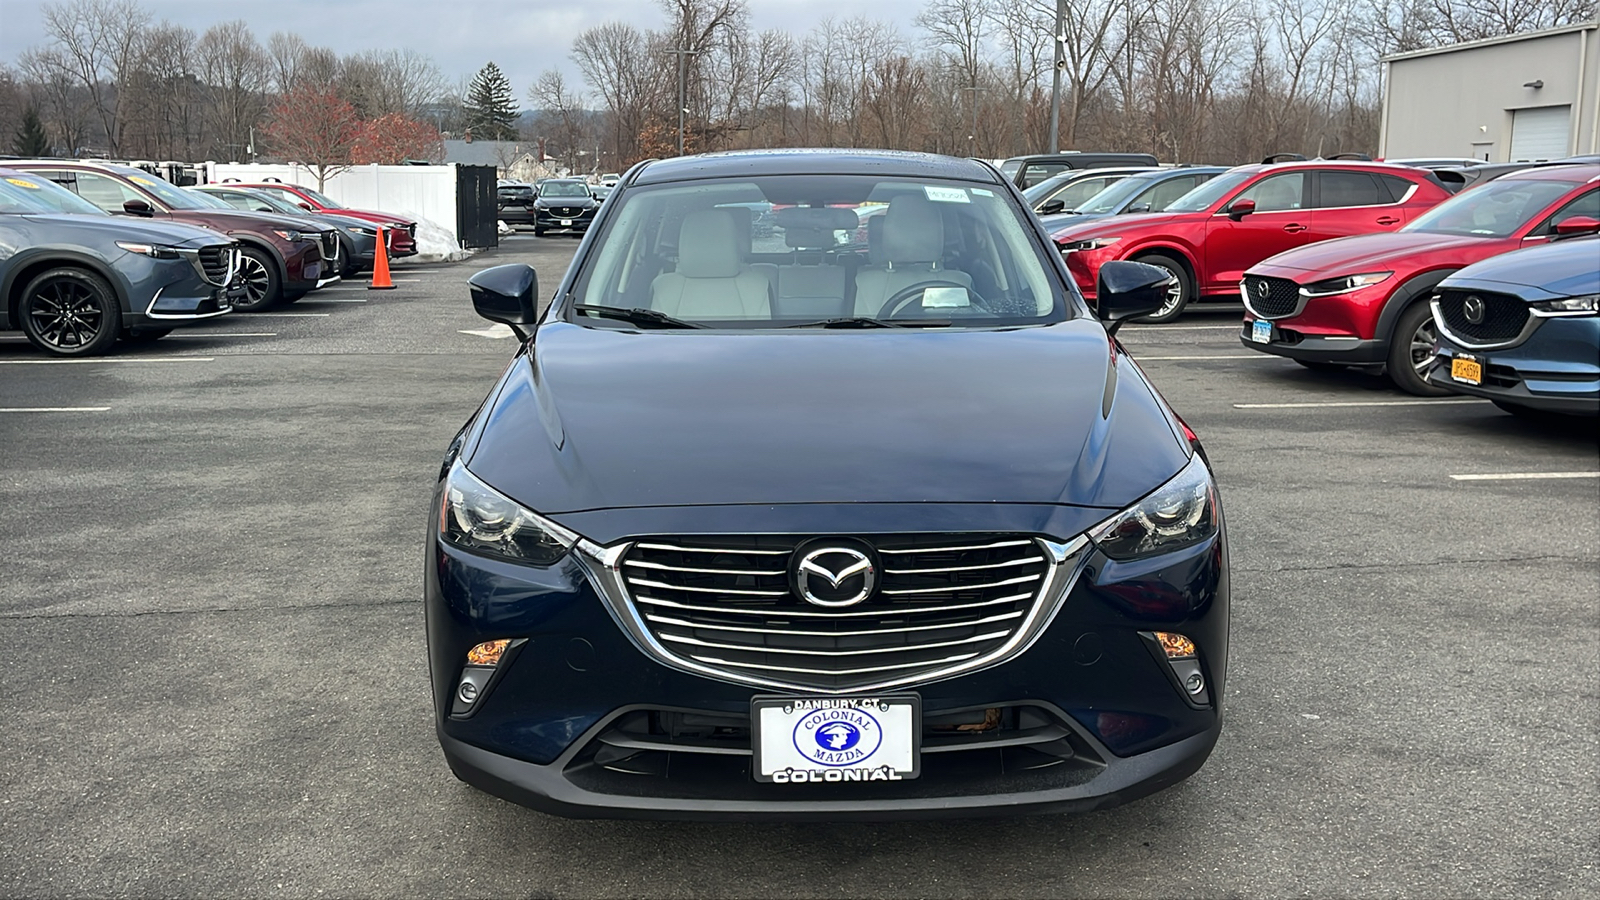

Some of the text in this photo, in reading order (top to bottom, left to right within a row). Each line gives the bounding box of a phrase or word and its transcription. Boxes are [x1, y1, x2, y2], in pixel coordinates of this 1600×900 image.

[804, 710, 871, 731] COLONIAL
[813, 748, 864, 763] MAZDA
[773, 769, 902, 783] COLONIAL
